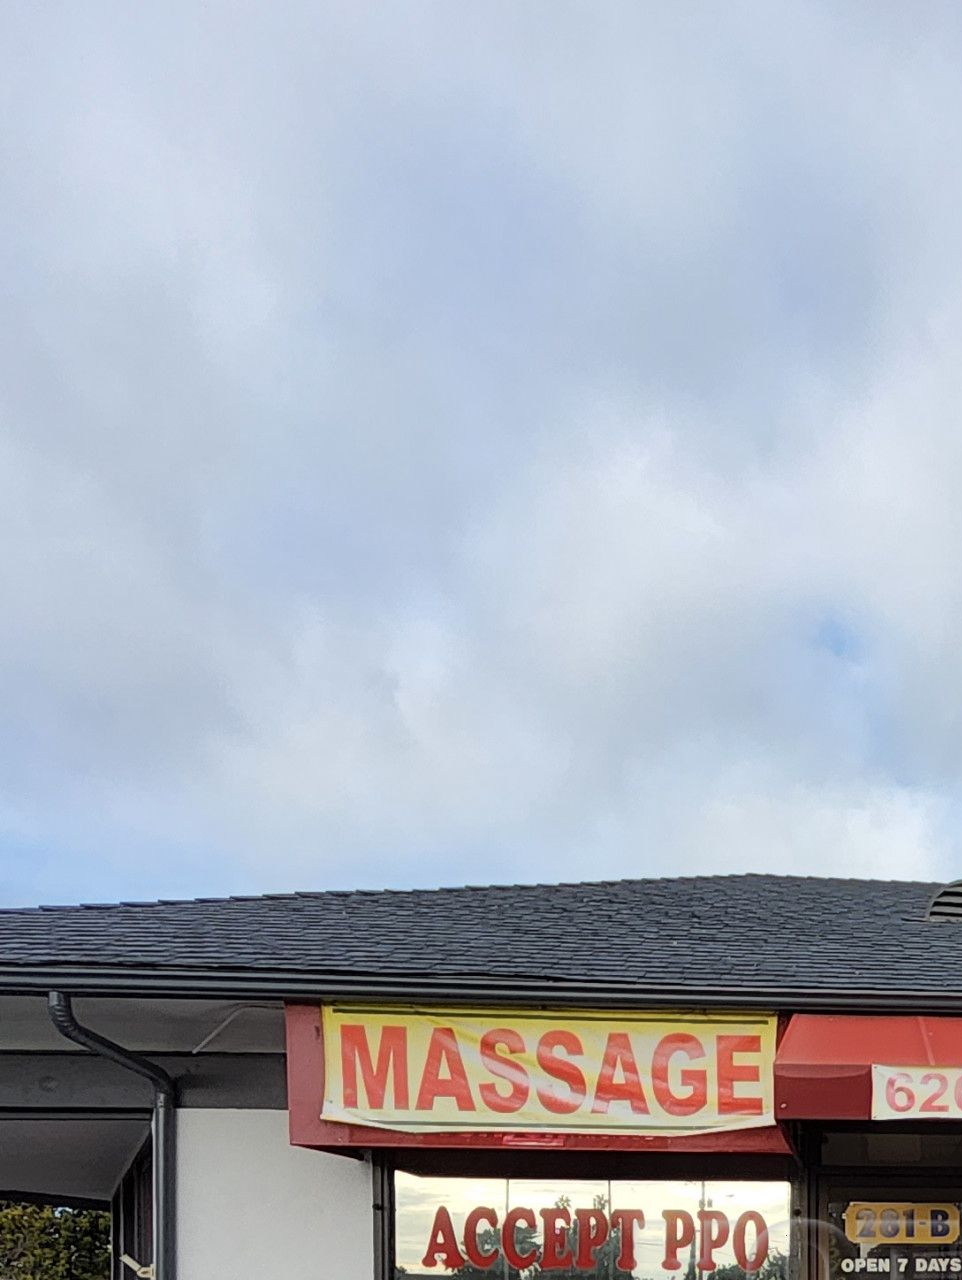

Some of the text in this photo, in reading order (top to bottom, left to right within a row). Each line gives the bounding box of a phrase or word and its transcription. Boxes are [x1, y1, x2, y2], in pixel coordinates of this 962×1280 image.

[340, 1024, 763, 1116] MASSAGE
[422, 1206, 770, 1272] ACCEPT PPO
[841, 1258, 962, 1272] OPEN 7 DAYS
